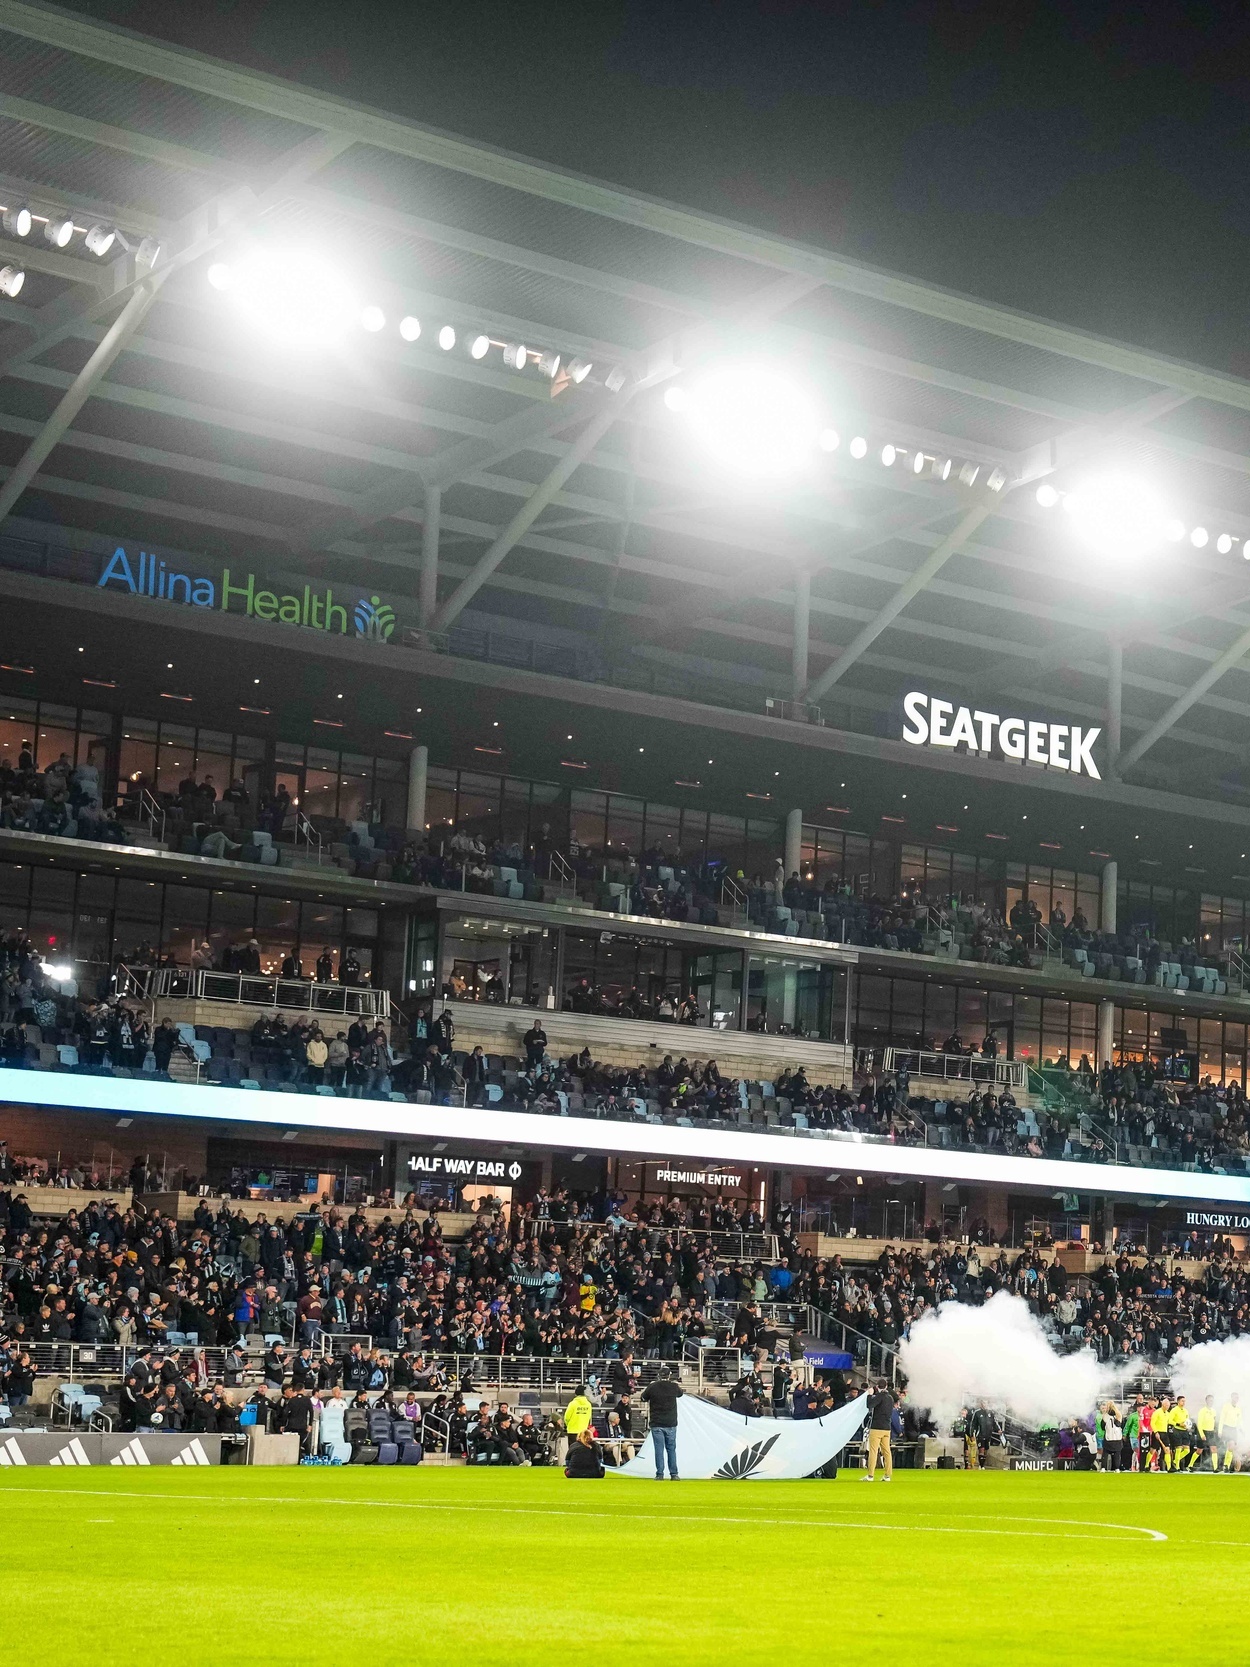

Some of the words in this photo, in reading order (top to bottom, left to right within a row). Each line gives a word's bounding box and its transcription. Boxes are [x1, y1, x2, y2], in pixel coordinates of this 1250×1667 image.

[97, 547, 215, 608] Allina
[221, 568, 348, 634] Health
[902, 691, 1102, 780] SEATGEEK
[444, 1158, 475, 1174] WAY
[476, 1161, 505, 1177] BAR
[657, 1170, 705, 1184] PREMIUM
[707, 1173, 741, 1186] ENTRY
[1186, 1212, 1233, 1227] HUNGRY
[809, 1357, 824, 1366] Field
[1015, 1460, 1054, 1471] MNUFC
